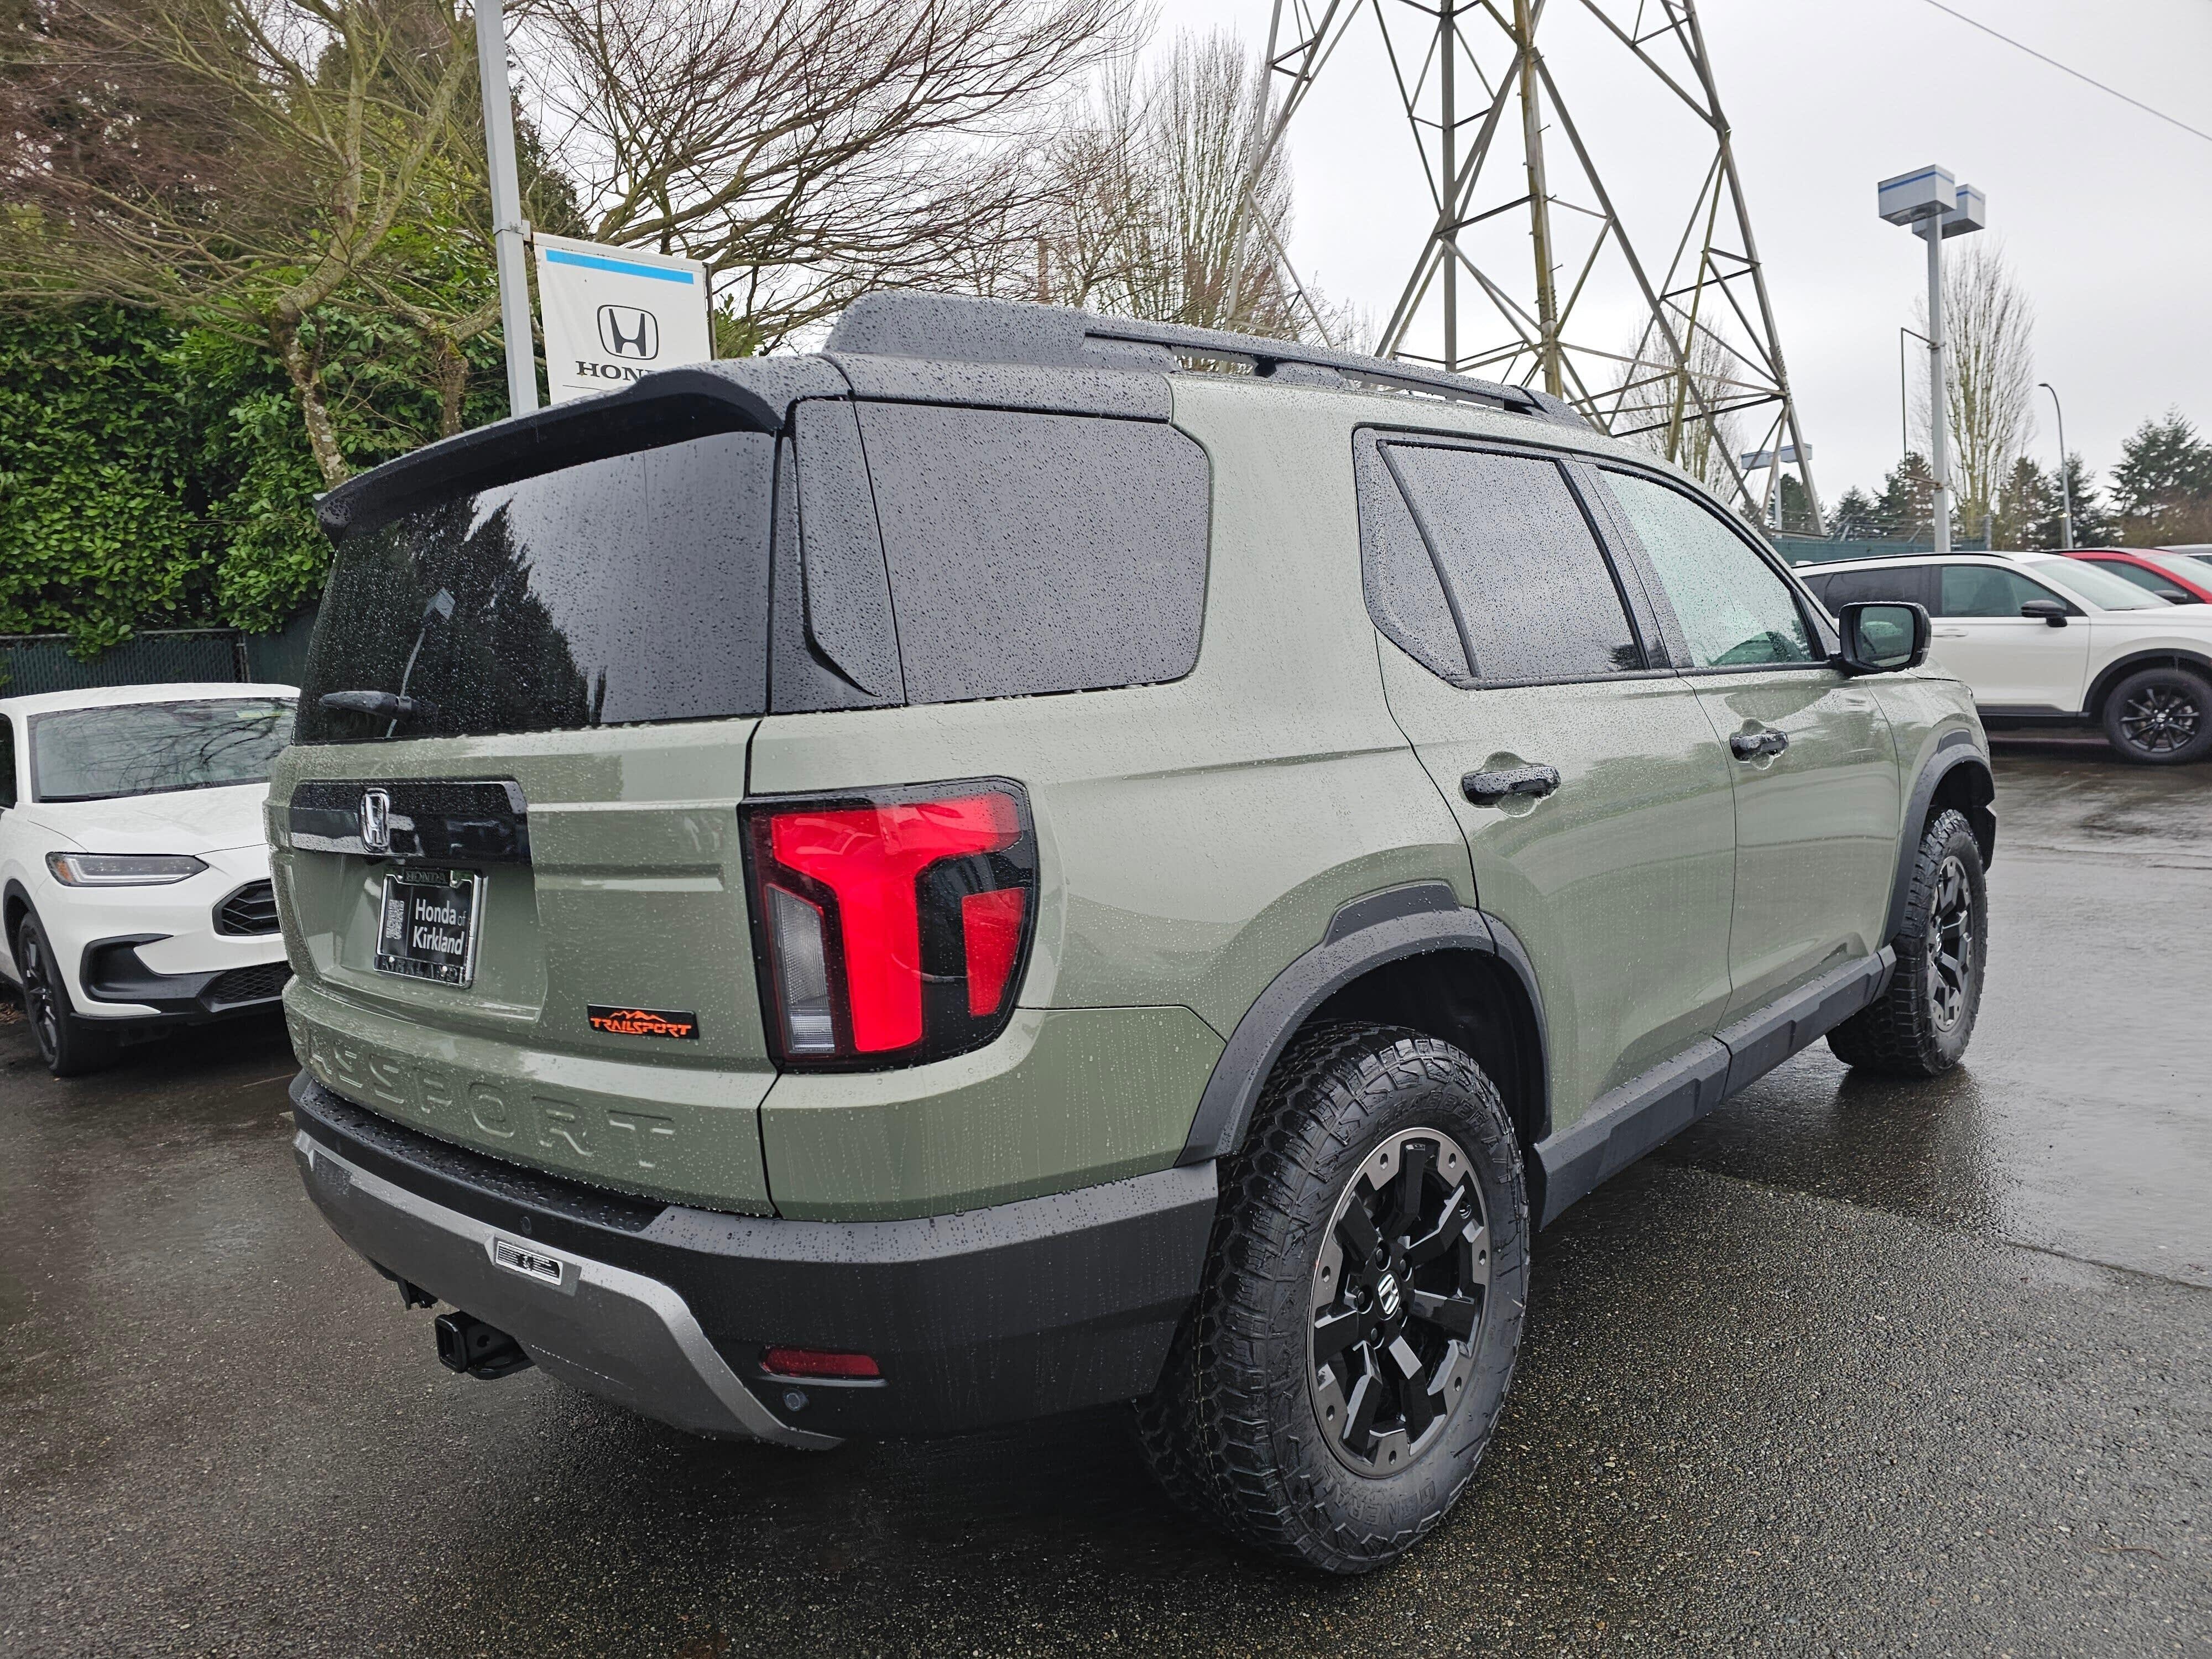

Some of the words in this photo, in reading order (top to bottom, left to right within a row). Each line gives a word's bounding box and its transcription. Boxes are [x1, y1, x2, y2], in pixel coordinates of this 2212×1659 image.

[576, 361, 655, 382] HON
[415, 898, 456, 925] Honda
[457, 910, 467, 927] of
[412, 926, 465, 956] Kirkland
[591, 1018, 691, 1037] TRAILSPORT
